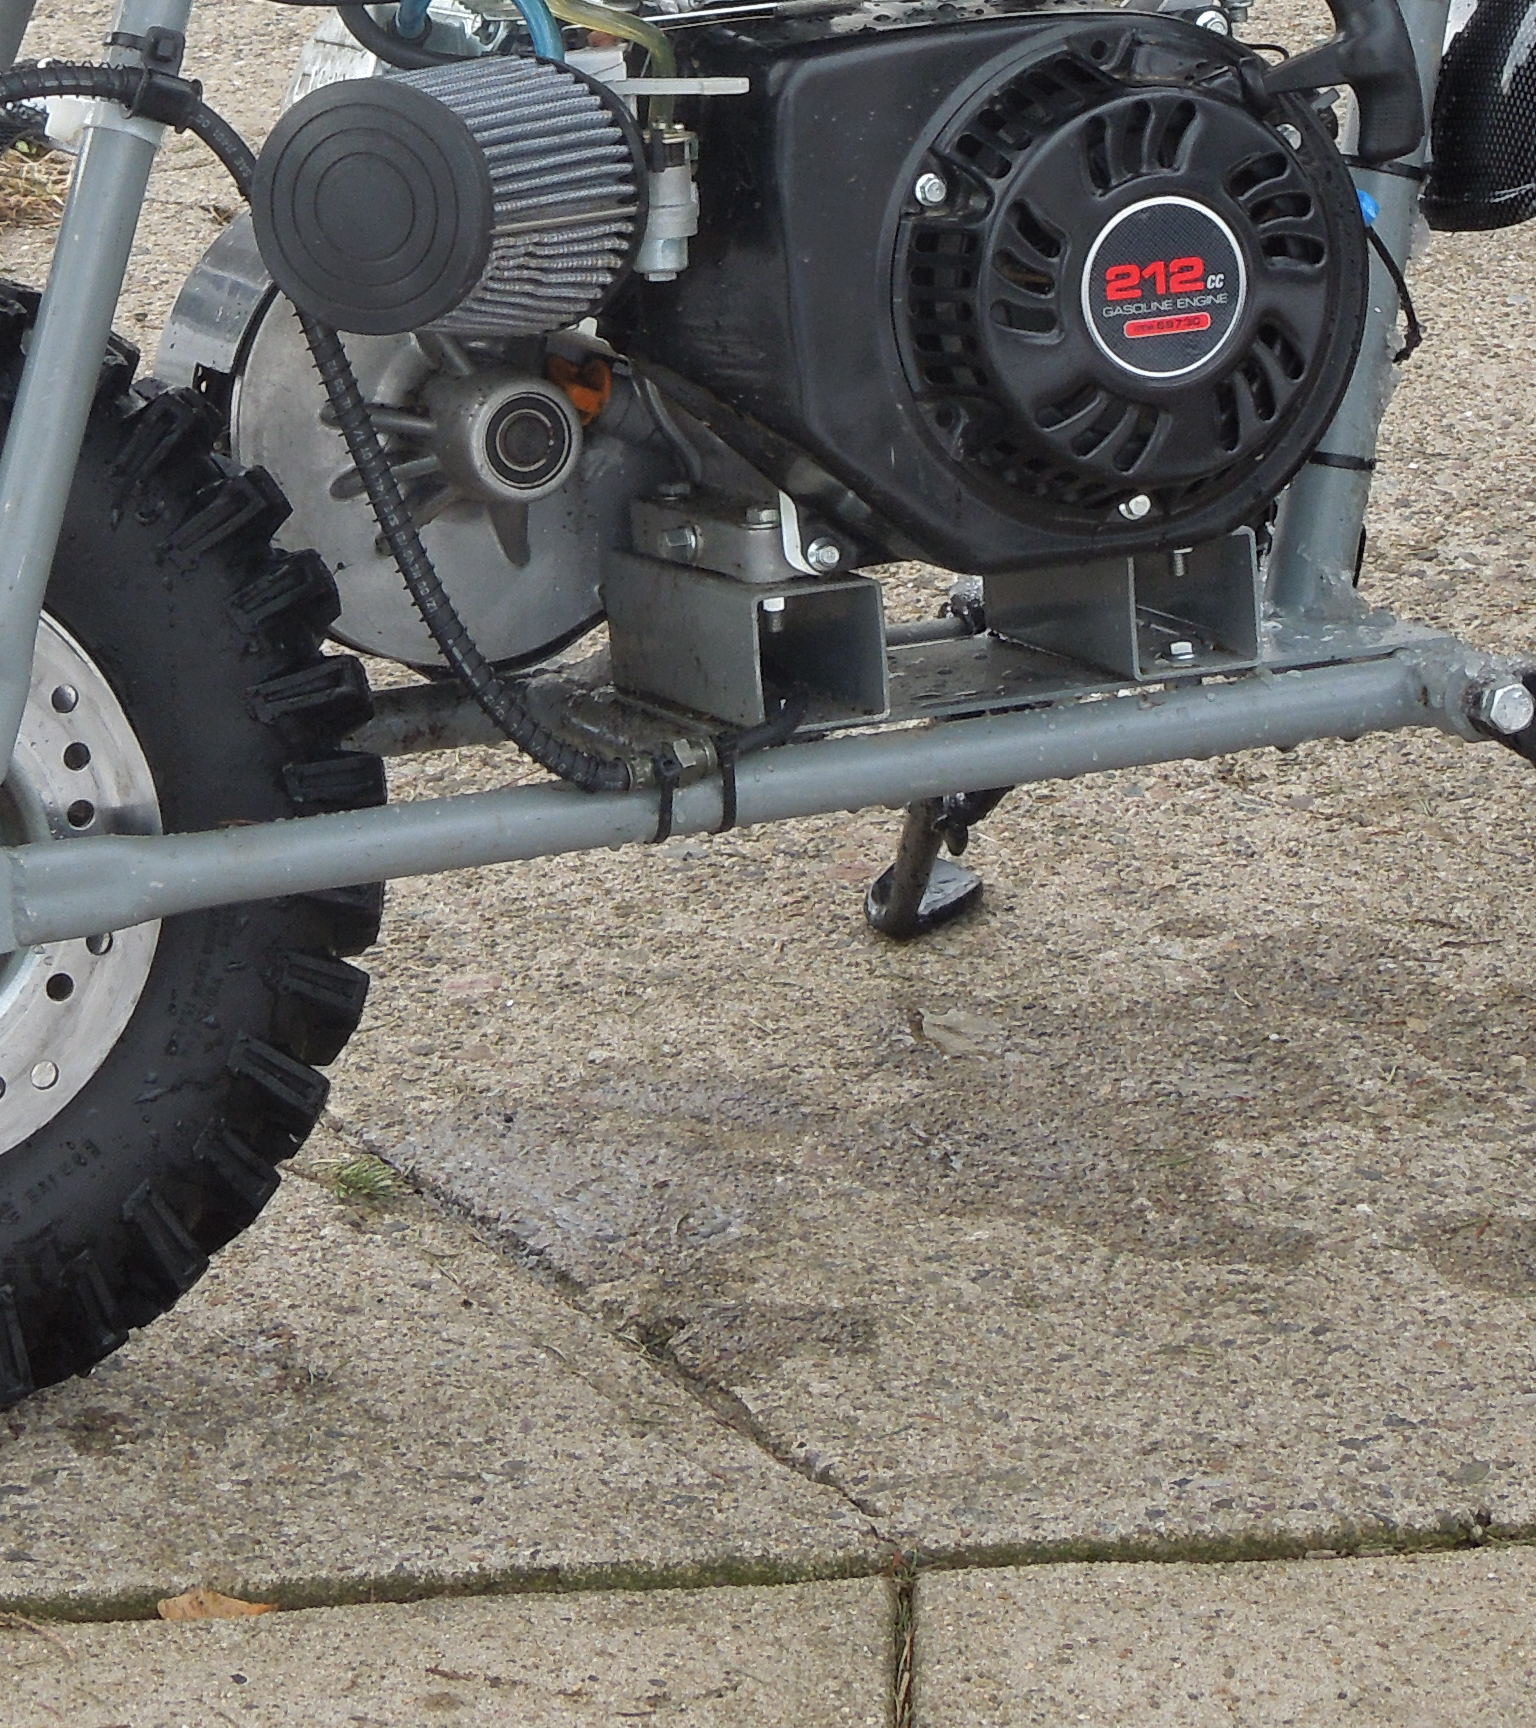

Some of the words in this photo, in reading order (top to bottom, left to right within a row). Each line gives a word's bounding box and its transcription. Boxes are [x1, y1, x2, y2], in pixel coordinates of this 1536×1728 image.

[1105, 256, 1205, 301] 212
[1102, 299, 1173, 317] GASOLINE
[1176, 293, 1228, 309] ENGINE
